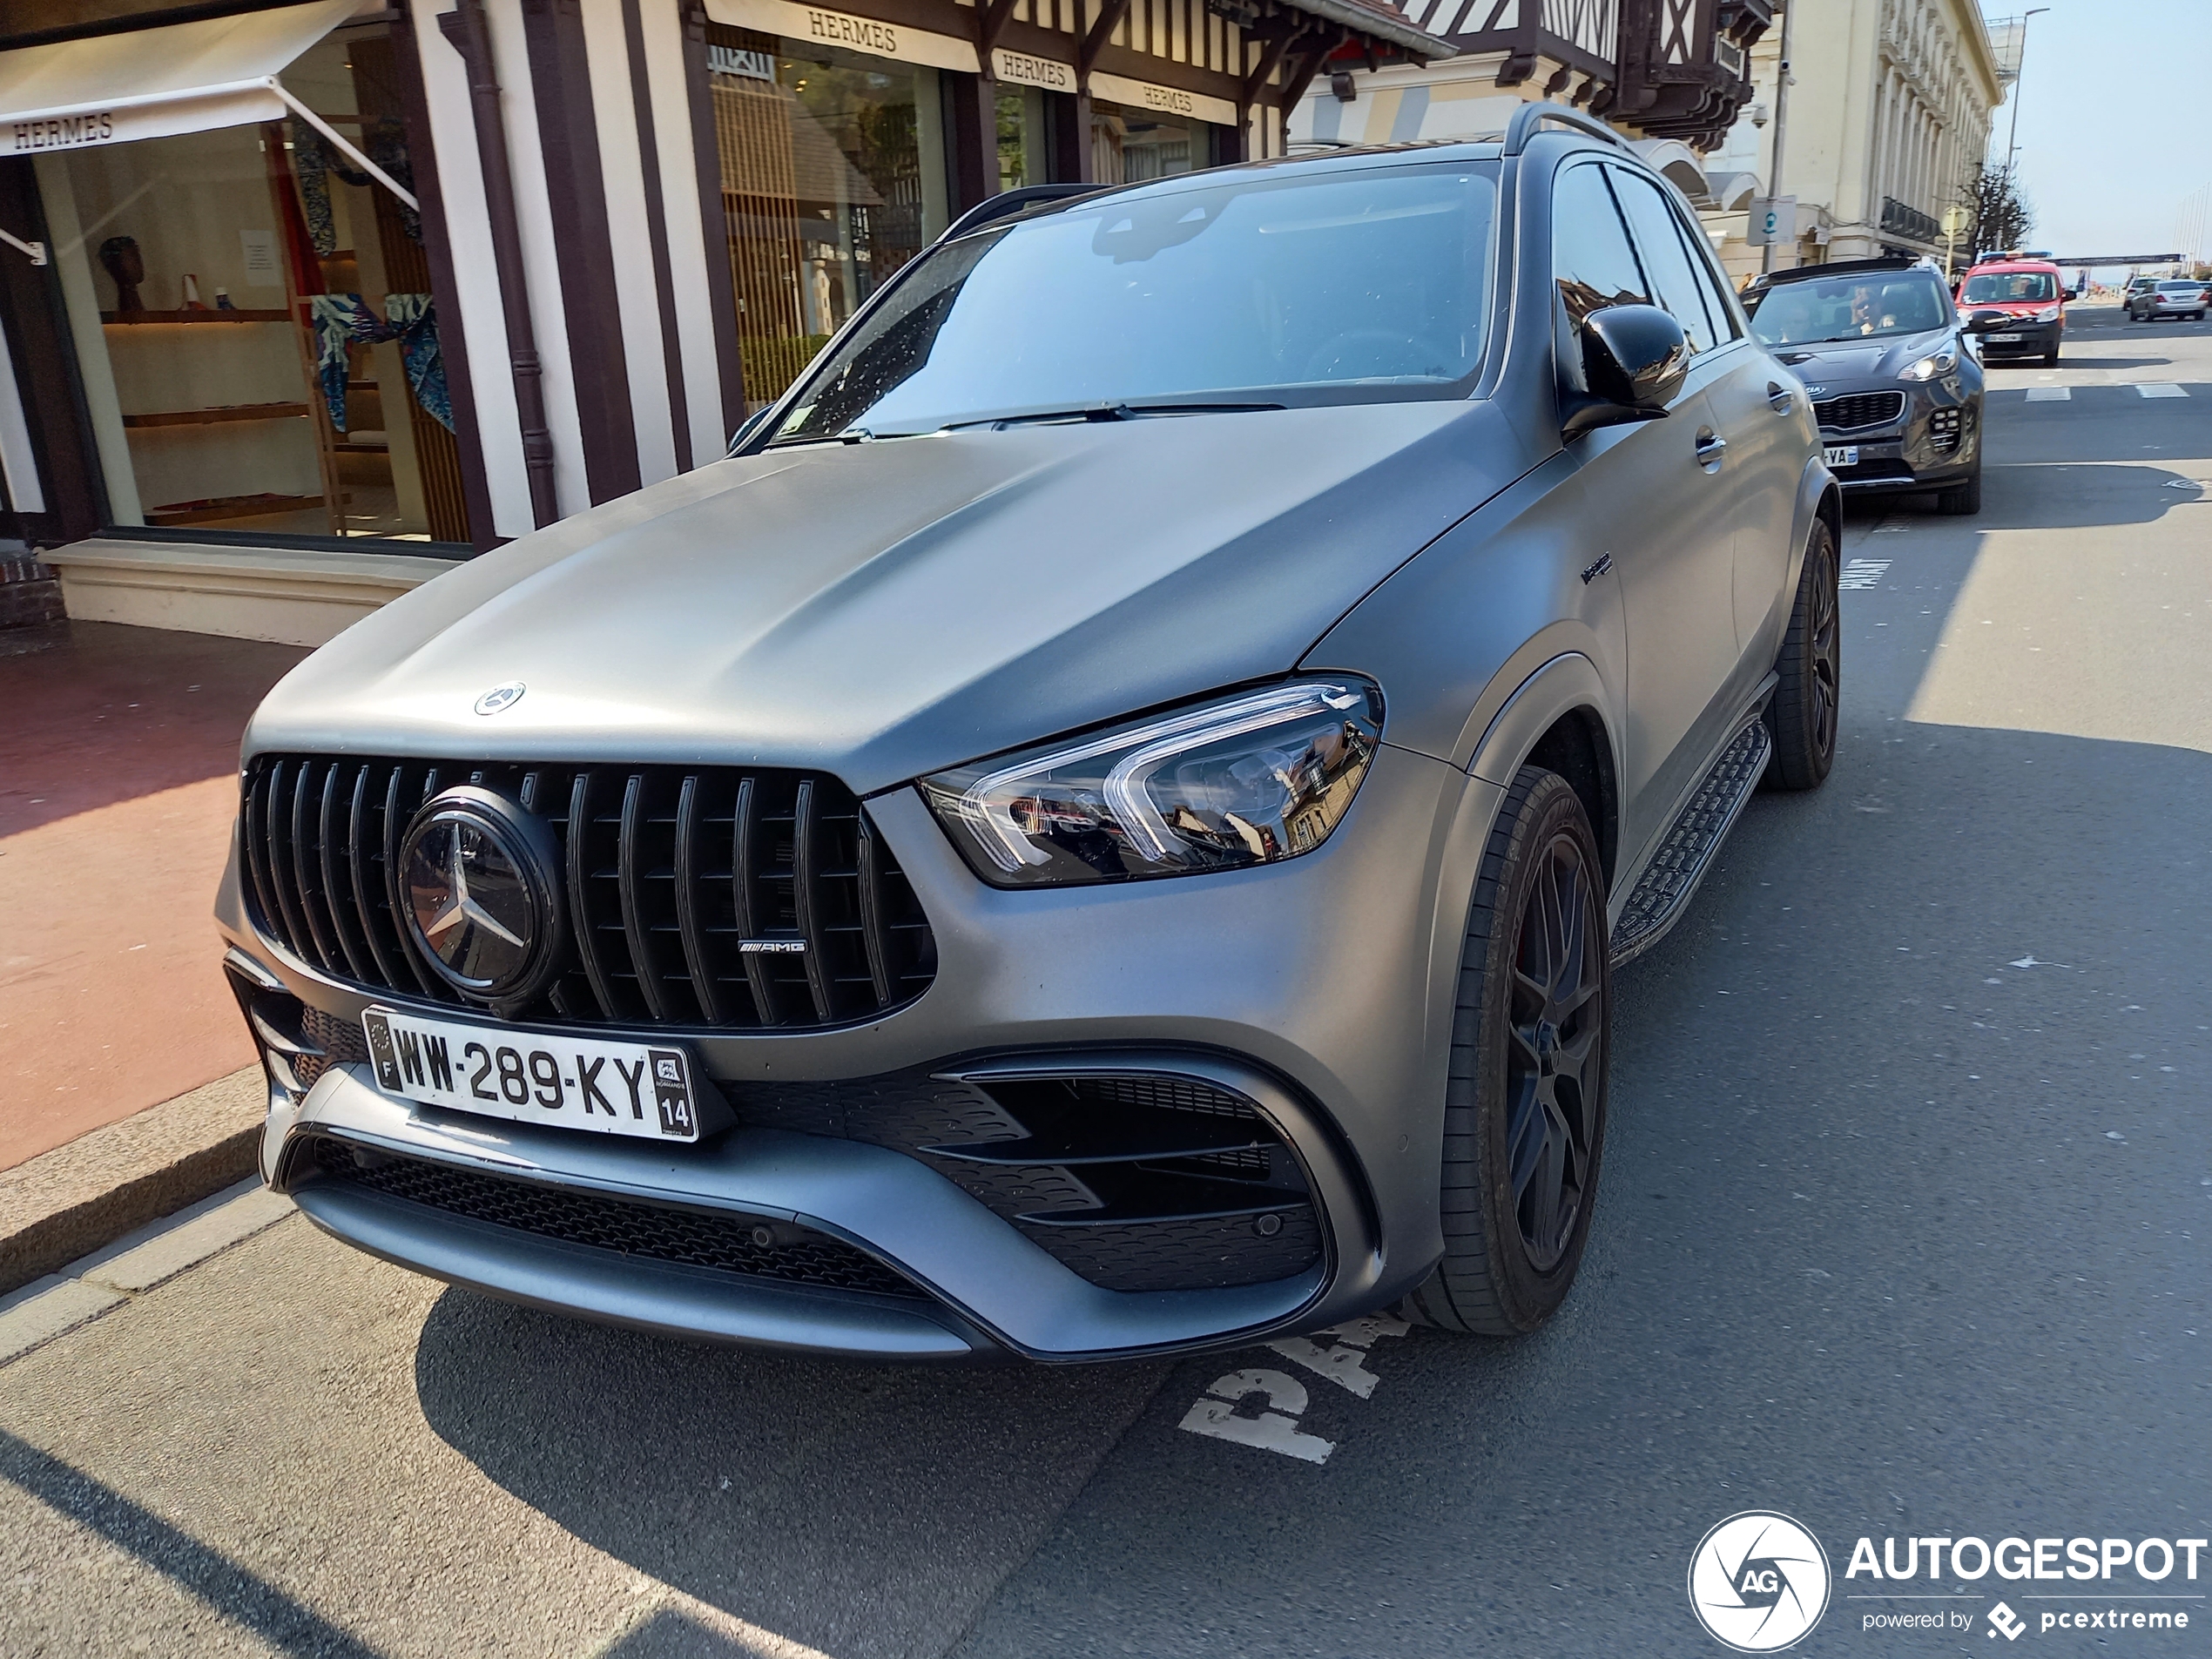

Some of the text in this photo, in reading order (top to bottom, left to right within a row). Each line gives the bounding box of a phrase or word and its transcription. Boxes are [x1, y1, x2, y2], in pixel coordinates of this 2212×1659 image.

[381, 1060, 392, 1078] F
[394, 1028, 644, 1120] WW-289-KY
[661, 1097, 689, 1128] 14
